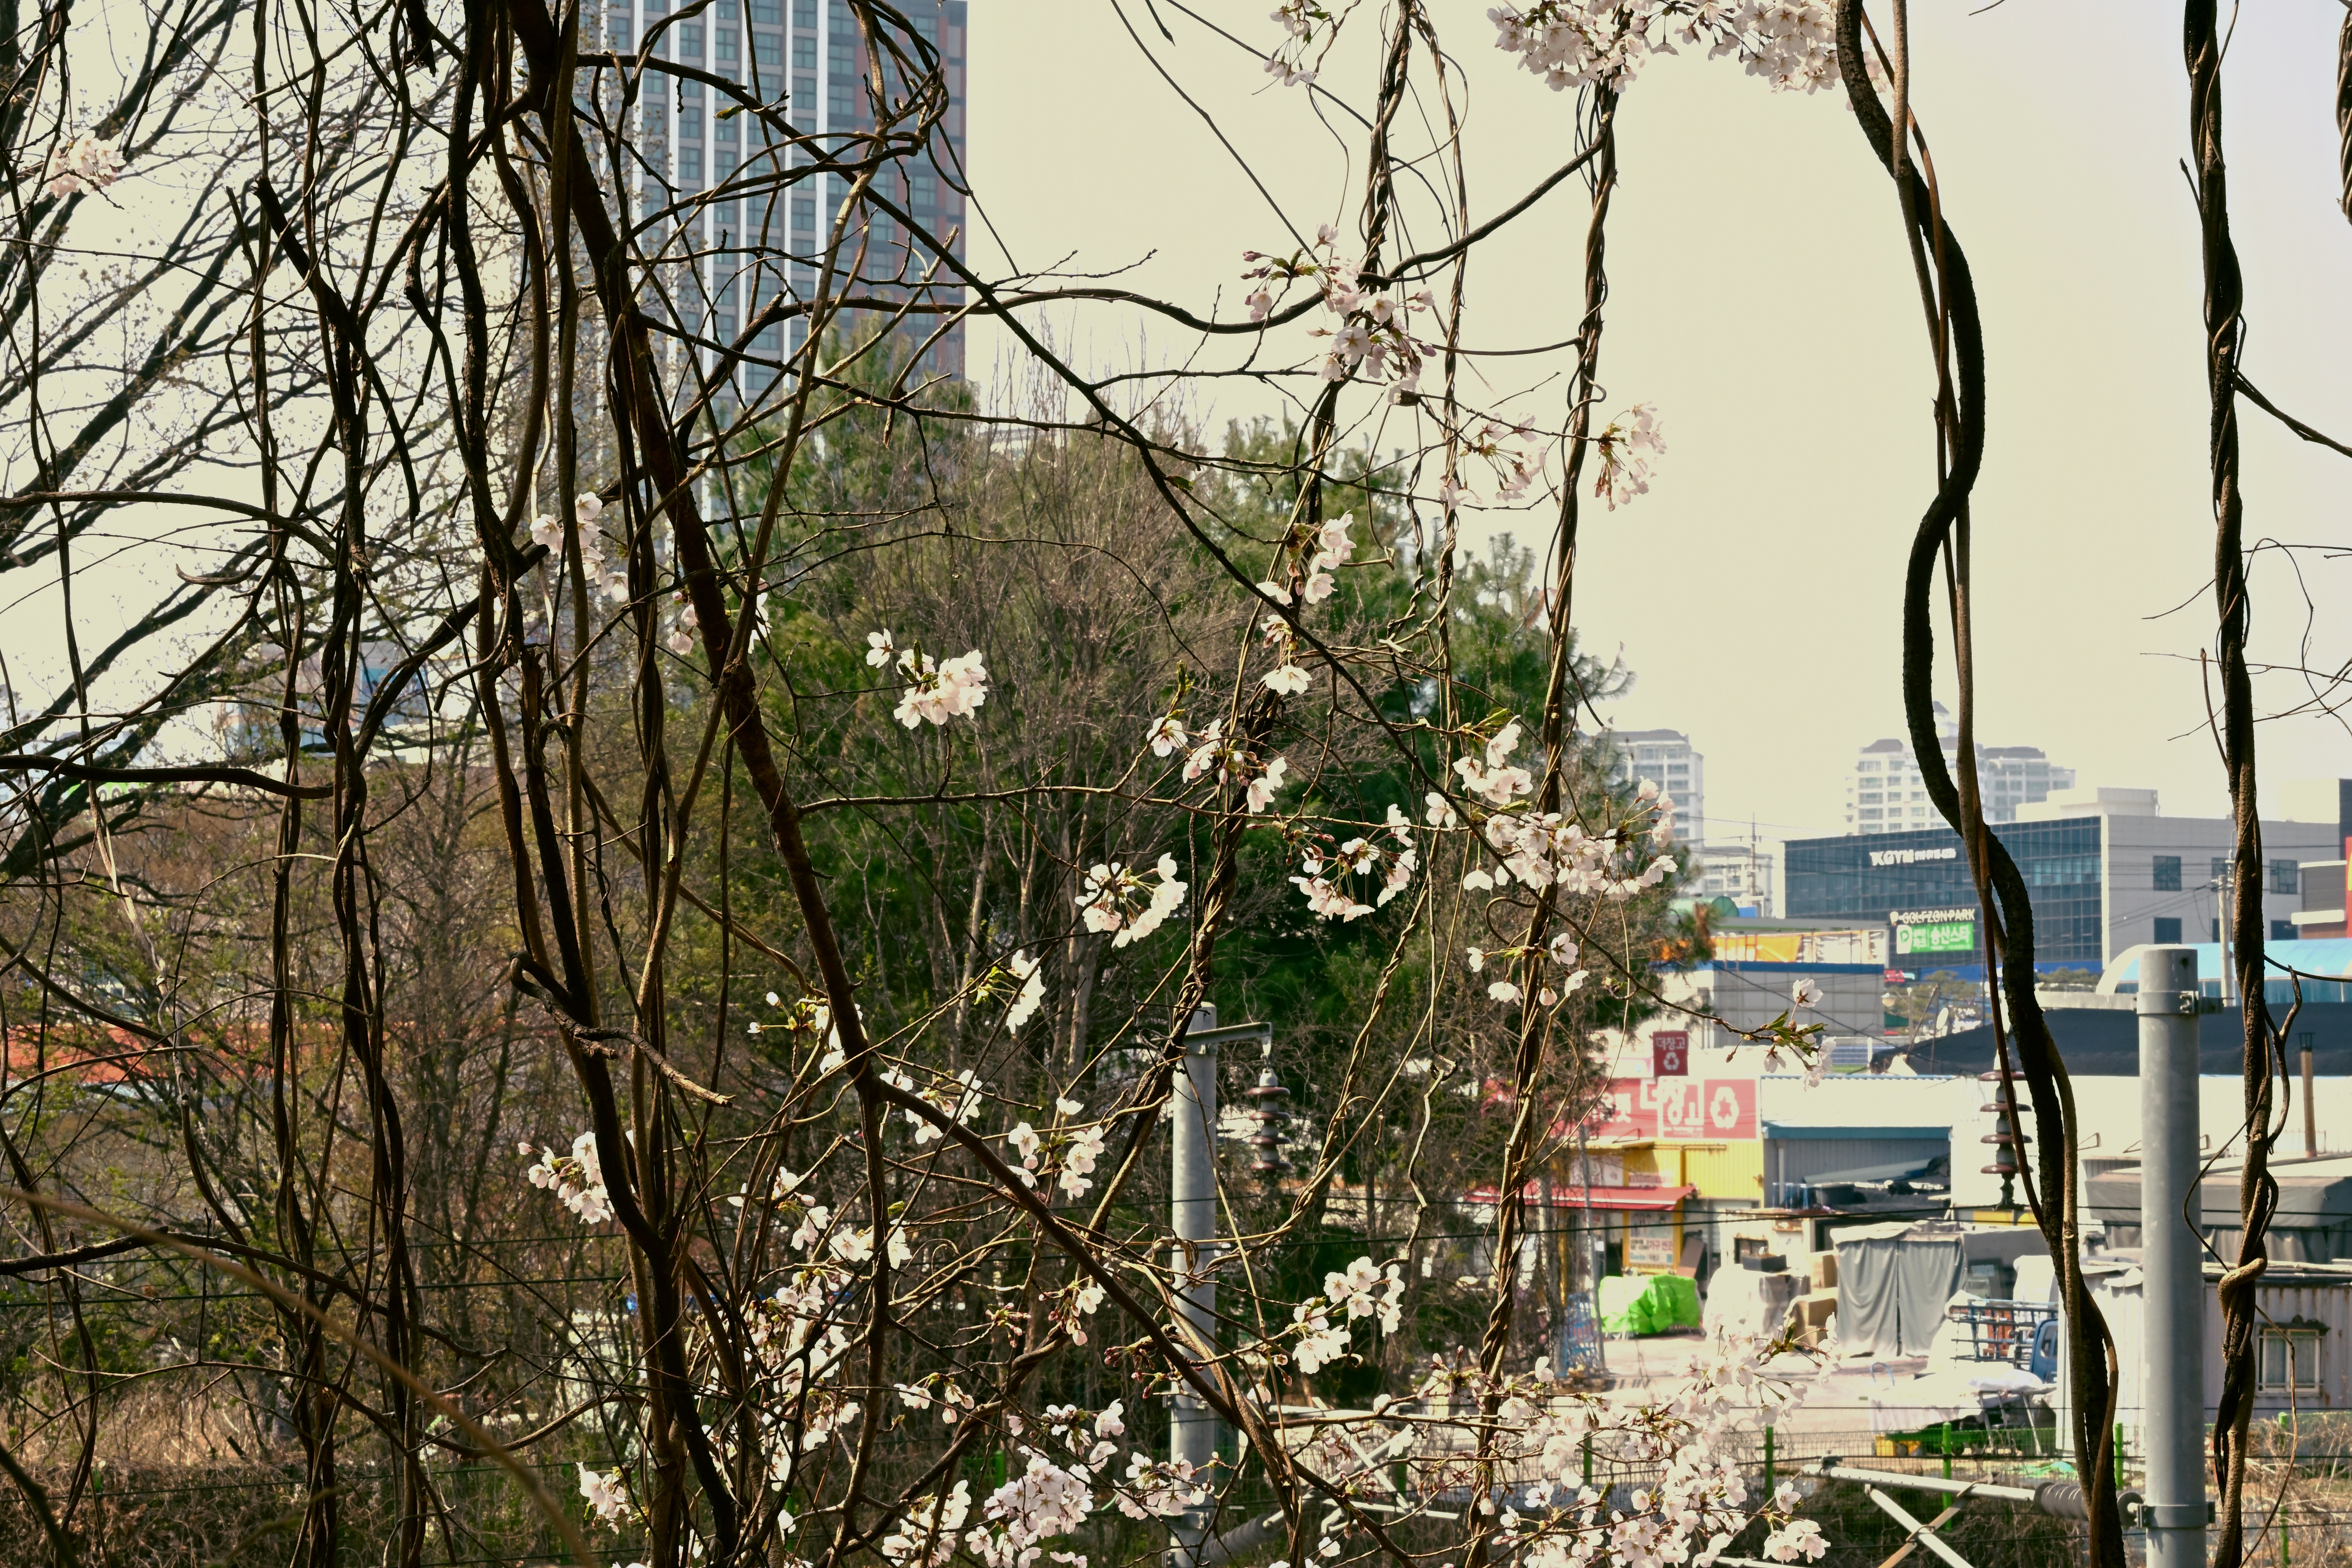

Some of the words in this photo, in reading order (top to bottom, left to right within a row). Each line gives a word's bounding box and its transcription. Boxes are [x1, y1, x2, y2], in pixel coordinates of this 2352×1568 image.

[1948, 909, 1975, 921] PARK
[1656, 1037, 1685, 1051] 더창고
[1640, 1076, 1704, 1126] 더창고
